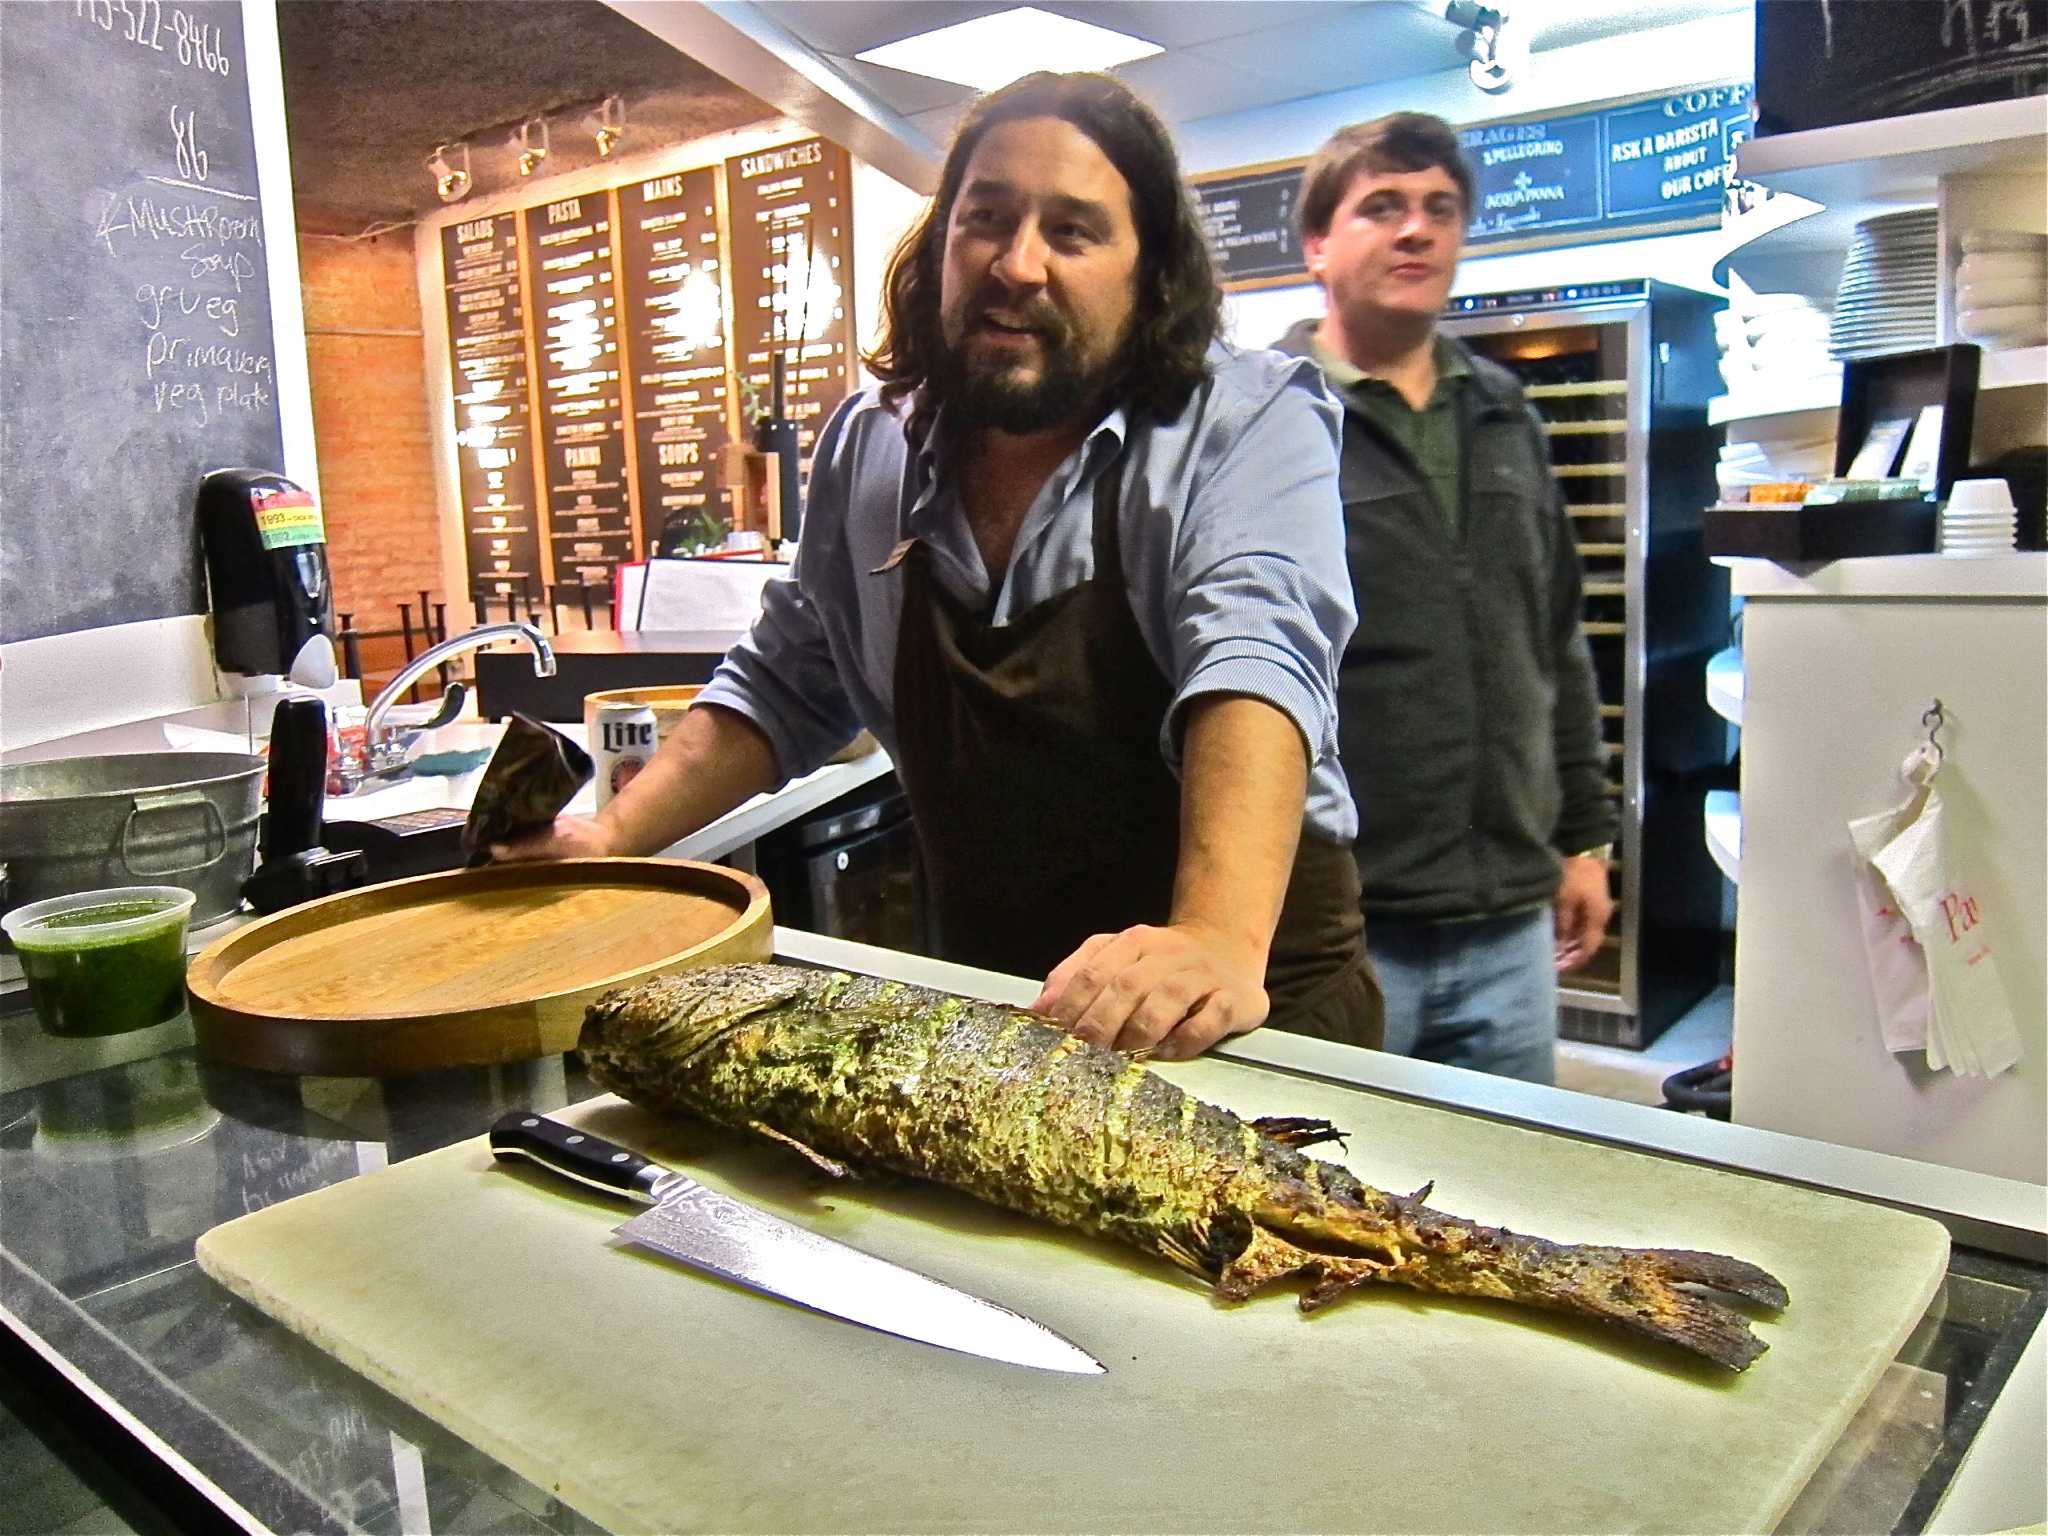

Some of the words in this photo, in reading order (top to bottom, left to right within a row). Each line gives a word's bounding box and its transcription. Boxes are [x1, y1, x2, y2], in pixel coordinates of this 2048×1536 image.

[170, 104, 208, 181] 86
[1612, 139, 1641, 162] ASK
[1642, 136, 1654, 156] A
[1655, 117, 1719, 153] BARISTA
[741, 142, 822, 179] SANDWICHES
[1664, 146, 1707, 173] ABOUT
[643, 175, 684, 202] MAINS
[1660, 175, 1692, 200] OUR
[547, 198, 581, 225] PASTA
[457, 219, 495, 244] SALADS
[659, 442, 699, 466] SOUPS
